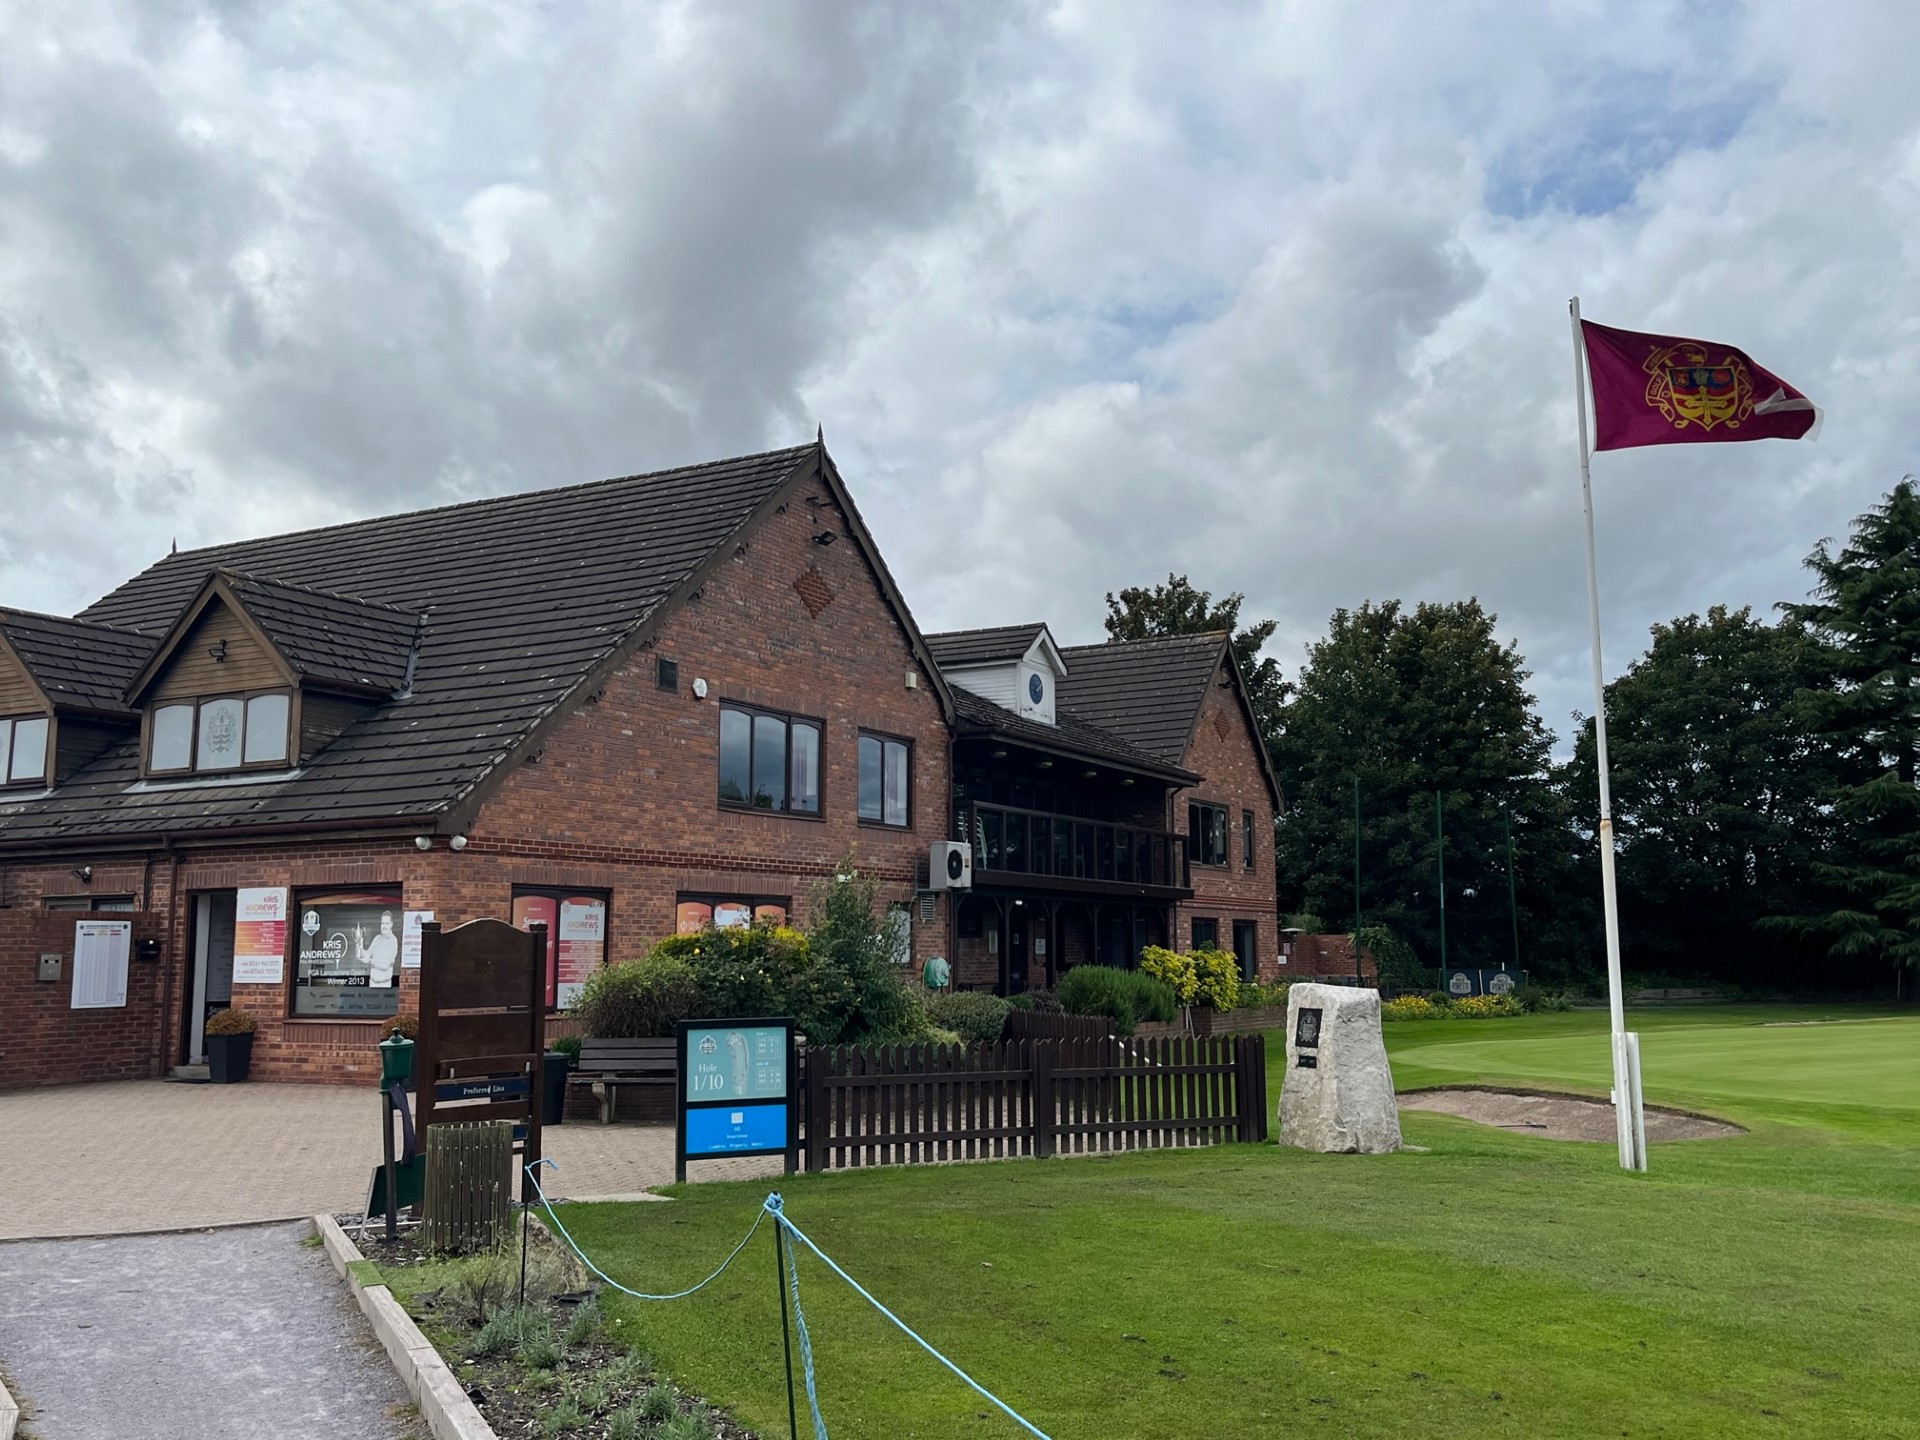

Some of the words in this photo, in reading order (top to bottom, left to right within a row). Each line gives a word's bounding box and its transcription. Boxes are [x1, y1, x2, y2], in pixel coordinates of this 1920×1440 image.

[1651, 377, 1662, 395] GOLF
[585, 913, 599, 921] KRIS
[567, 921, 599, 929] ANDREWS
[322, 940, 341, 949] KRIS
[300, 950, 341, 959] ANDREWS
[350, 969, 366, 977] Open
[327, 977, 347, 985] Winner
[348, 977, 365, 985] 2013
[698, 1063, 717, 1073] Hole
[694, 1074, 724, 1091] 1/10
